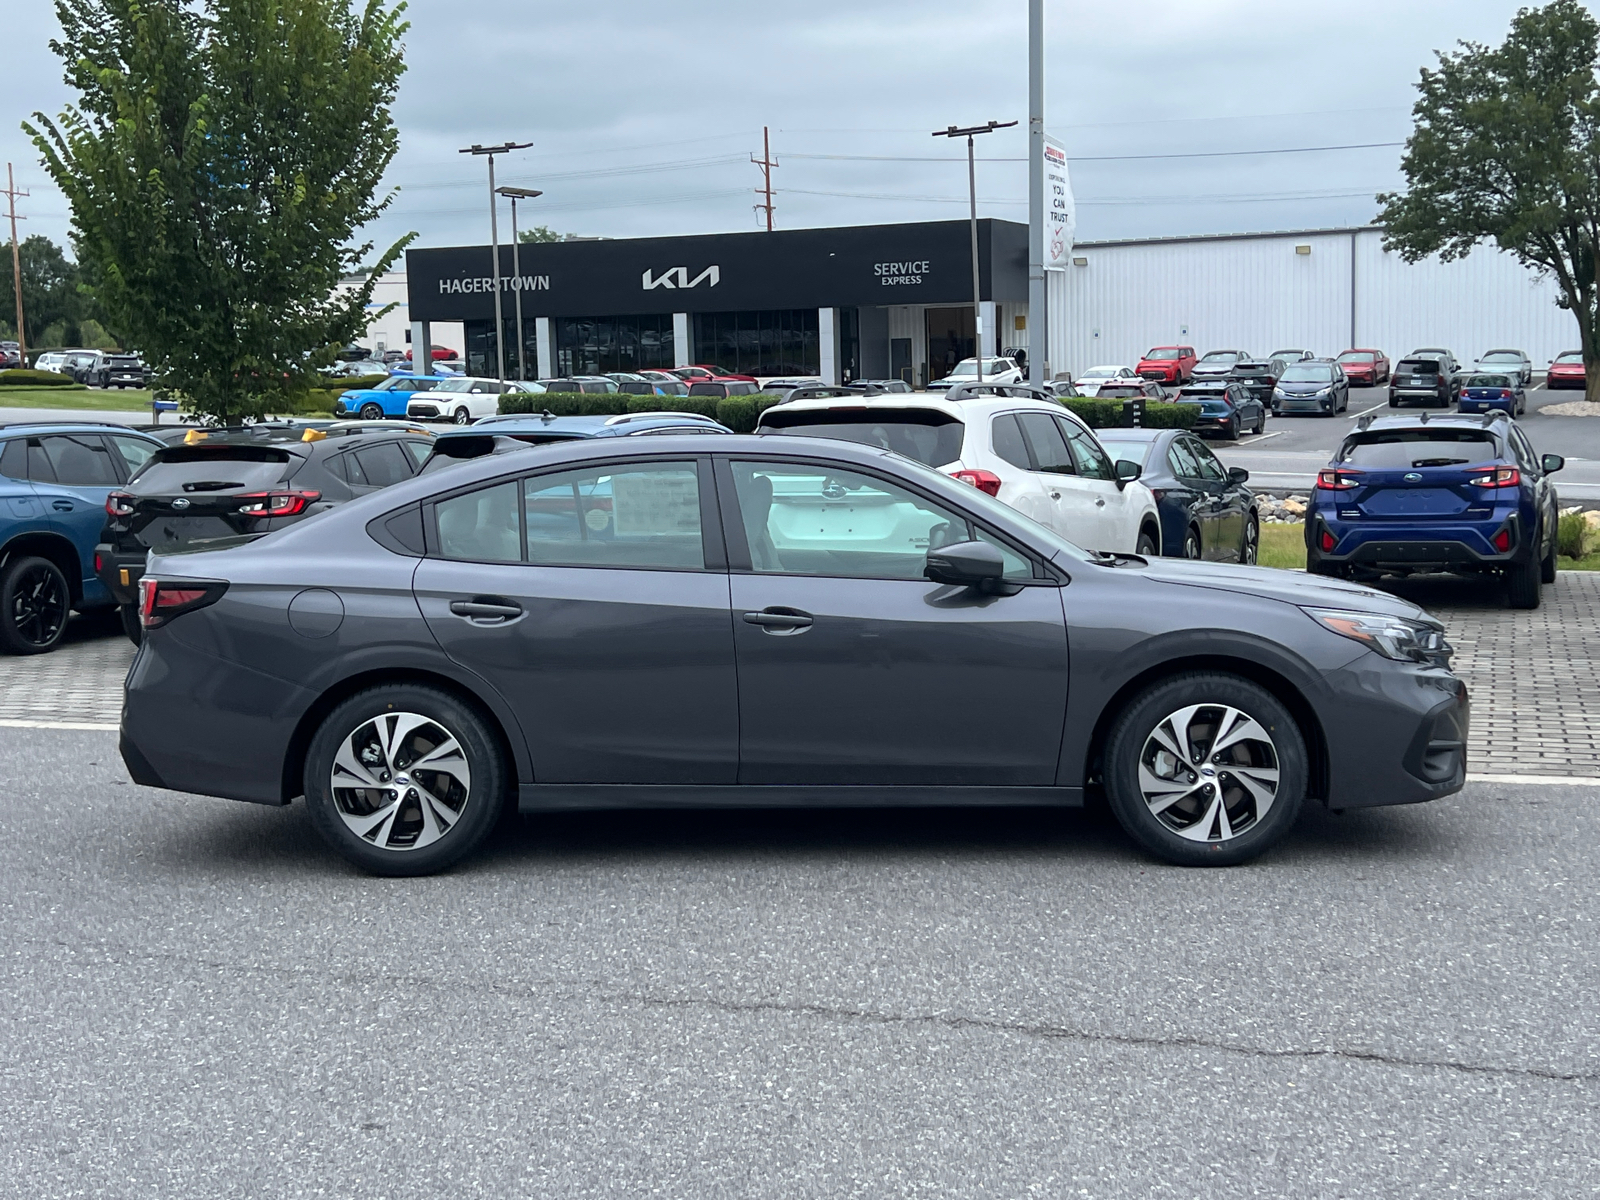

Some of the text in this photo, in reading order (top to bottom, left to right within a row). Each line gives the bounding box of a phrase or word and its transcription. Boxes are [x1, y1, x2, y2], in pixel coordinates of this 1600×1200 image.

[1053, 184, 1064, 196] YOU
[1053, 197, 1065, 209] CAN
[1050, 211, 1068, 224] TRUST
[874, 260, 930, 276] SERVICE
[642, 265, 720, 290] KIA
[881, 275, 922, 286] EXPRESS
